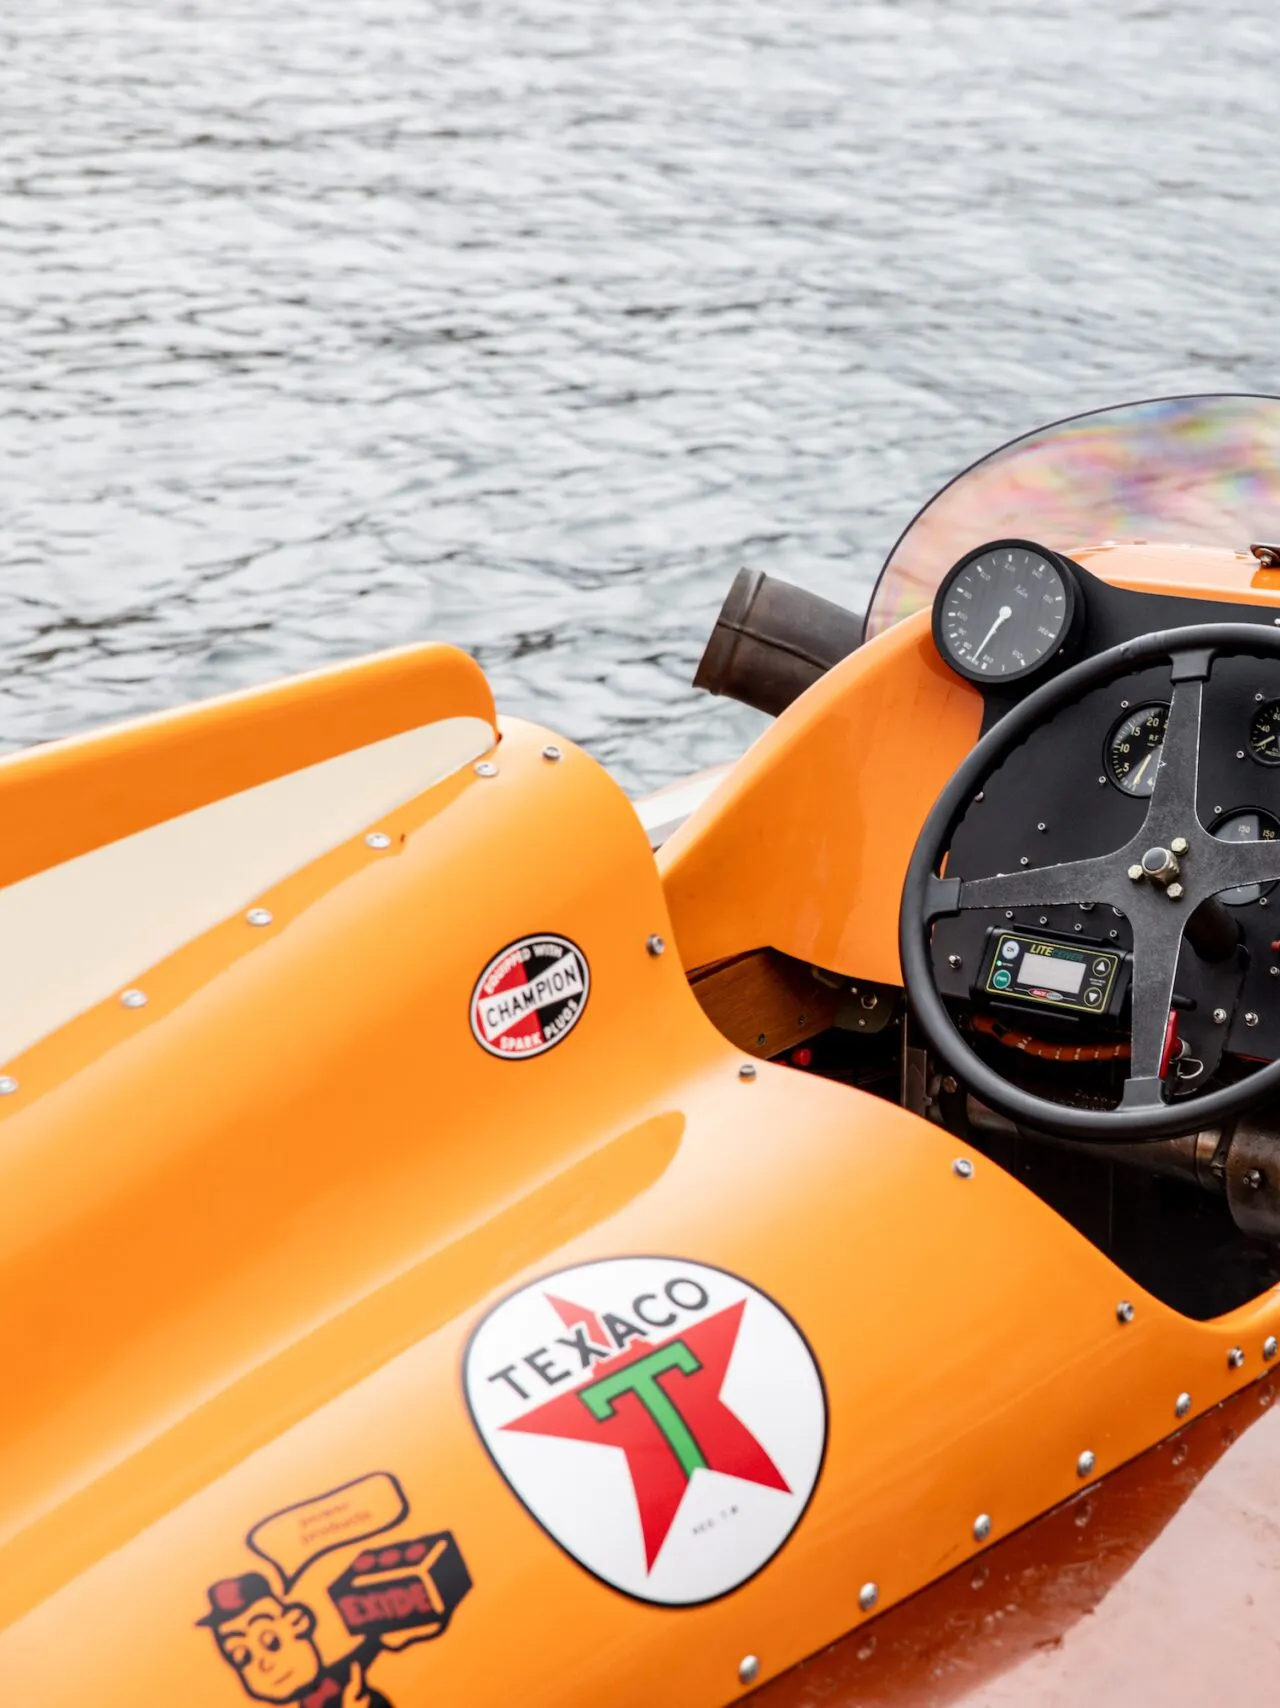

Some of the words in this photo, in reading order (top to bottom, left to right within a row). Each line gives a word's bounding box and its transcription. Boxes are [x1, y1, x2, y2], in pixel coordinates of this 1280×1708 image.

[1146, 717, 1159, 726] 20
[1131, 727, 1141, 736] 15
[1120, 744, 1129, 752] 10
[1123, 763, 1129, 772] 5
[1238, 825, 1250, 833] 150
[1263, 830, 1275, 838] 150
[486, 965, 577, 1027] CHAMPION
[500, 1032, 543, 1050] SPARK
[543, 999, 578, 1039] PLUGS
[487, 1276, 711, 1402] TEXACO
[338, 1582, 433, 1627] EXIDE
